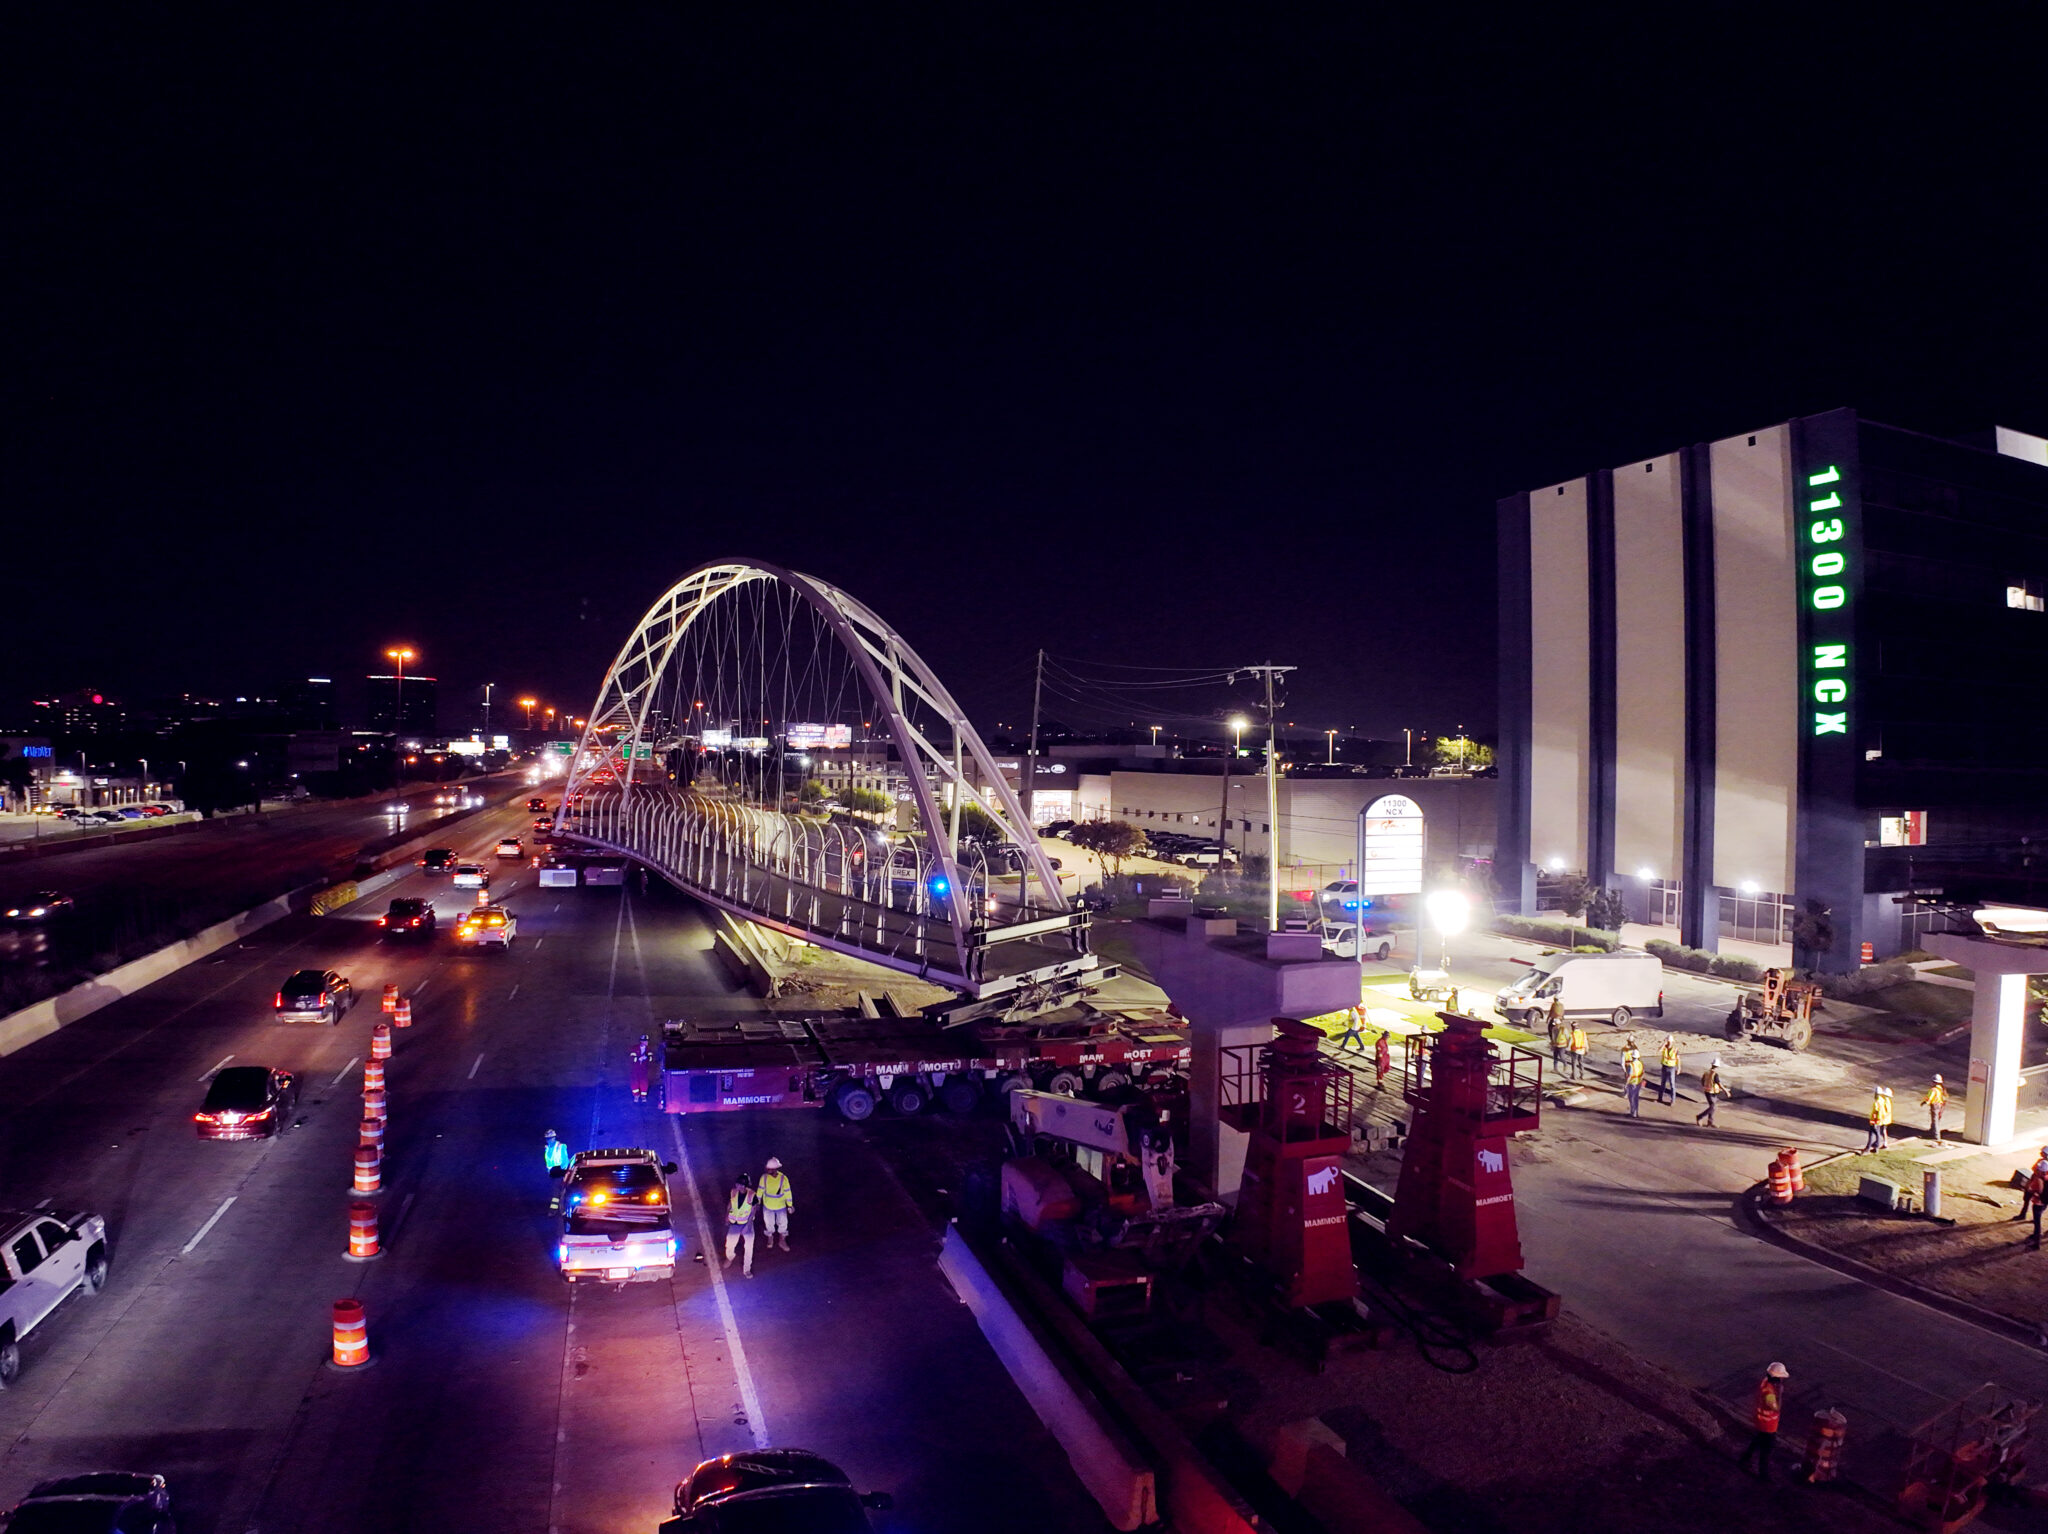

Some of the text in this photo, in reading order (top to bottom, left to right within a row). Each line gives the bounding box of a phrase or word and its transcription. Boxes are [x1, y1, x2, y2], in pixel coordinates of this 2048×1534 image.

[1809, 465, 1848, 736] 11300 NCX
[1386, 808, 1403, 816] NCX
[889, 868, 911, 877] EREX
[723, 1096, 771, 1105] MAMMOET
[1293, 1093, 1306, 1115] 2
[1475, 1193, 1513, 1207] MAMMOET
[1304, 1215, 1347, 1228] MAMMOET
